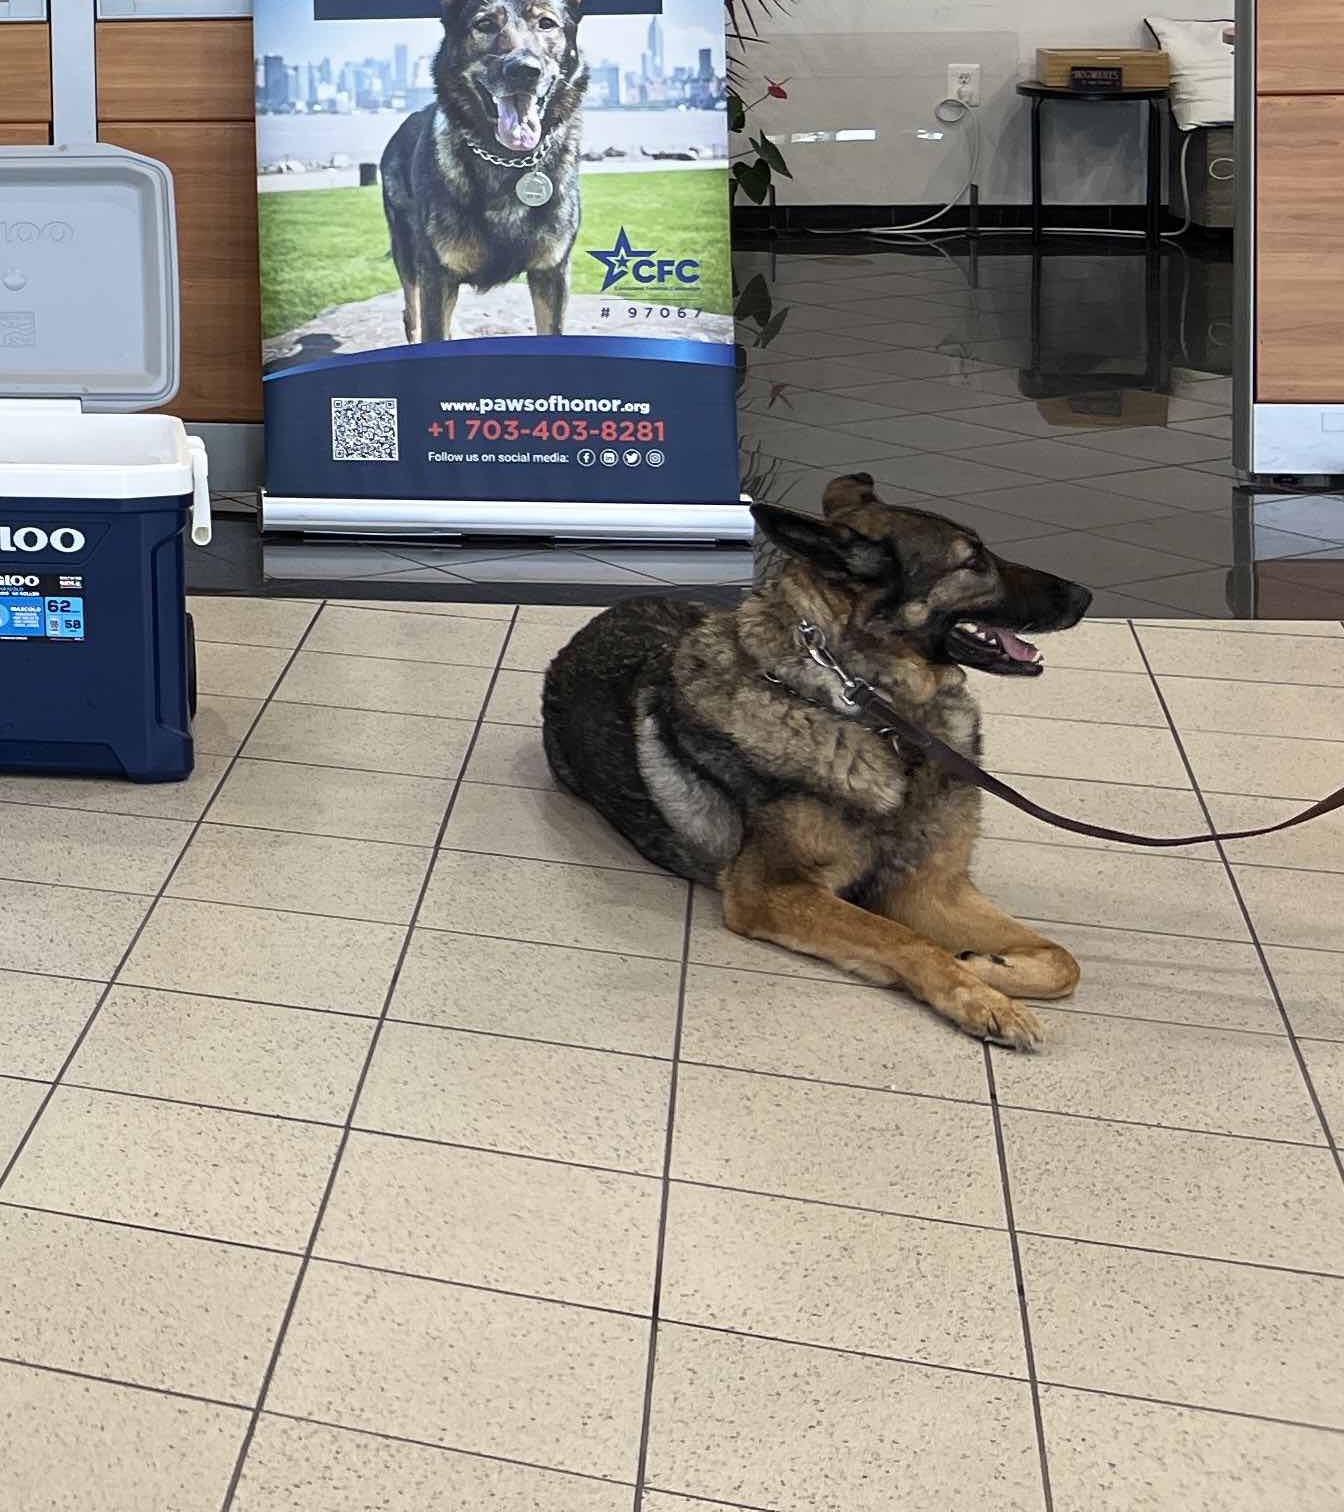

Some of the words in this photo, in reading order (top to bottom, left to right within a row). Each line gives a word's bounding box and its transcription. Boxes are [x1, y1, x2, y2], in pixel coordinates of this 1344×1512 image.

[633, 259, 700, 283] CFC
[440, 395, 650, 415] www.pawsofhonor.org
[428, 420, 455, 440] +1
[465, 419, 665, 441] 703-403-8281
[428, 451, 464, 464] Follow
[465, 453, 479, 462] us
[481, 453, 496, 463] on
[498, 451, 530, 463] social
[533, 452, 569, 464] media:
[47, 600, 71, 613] 62
[65, 619, 81, 629] 58
